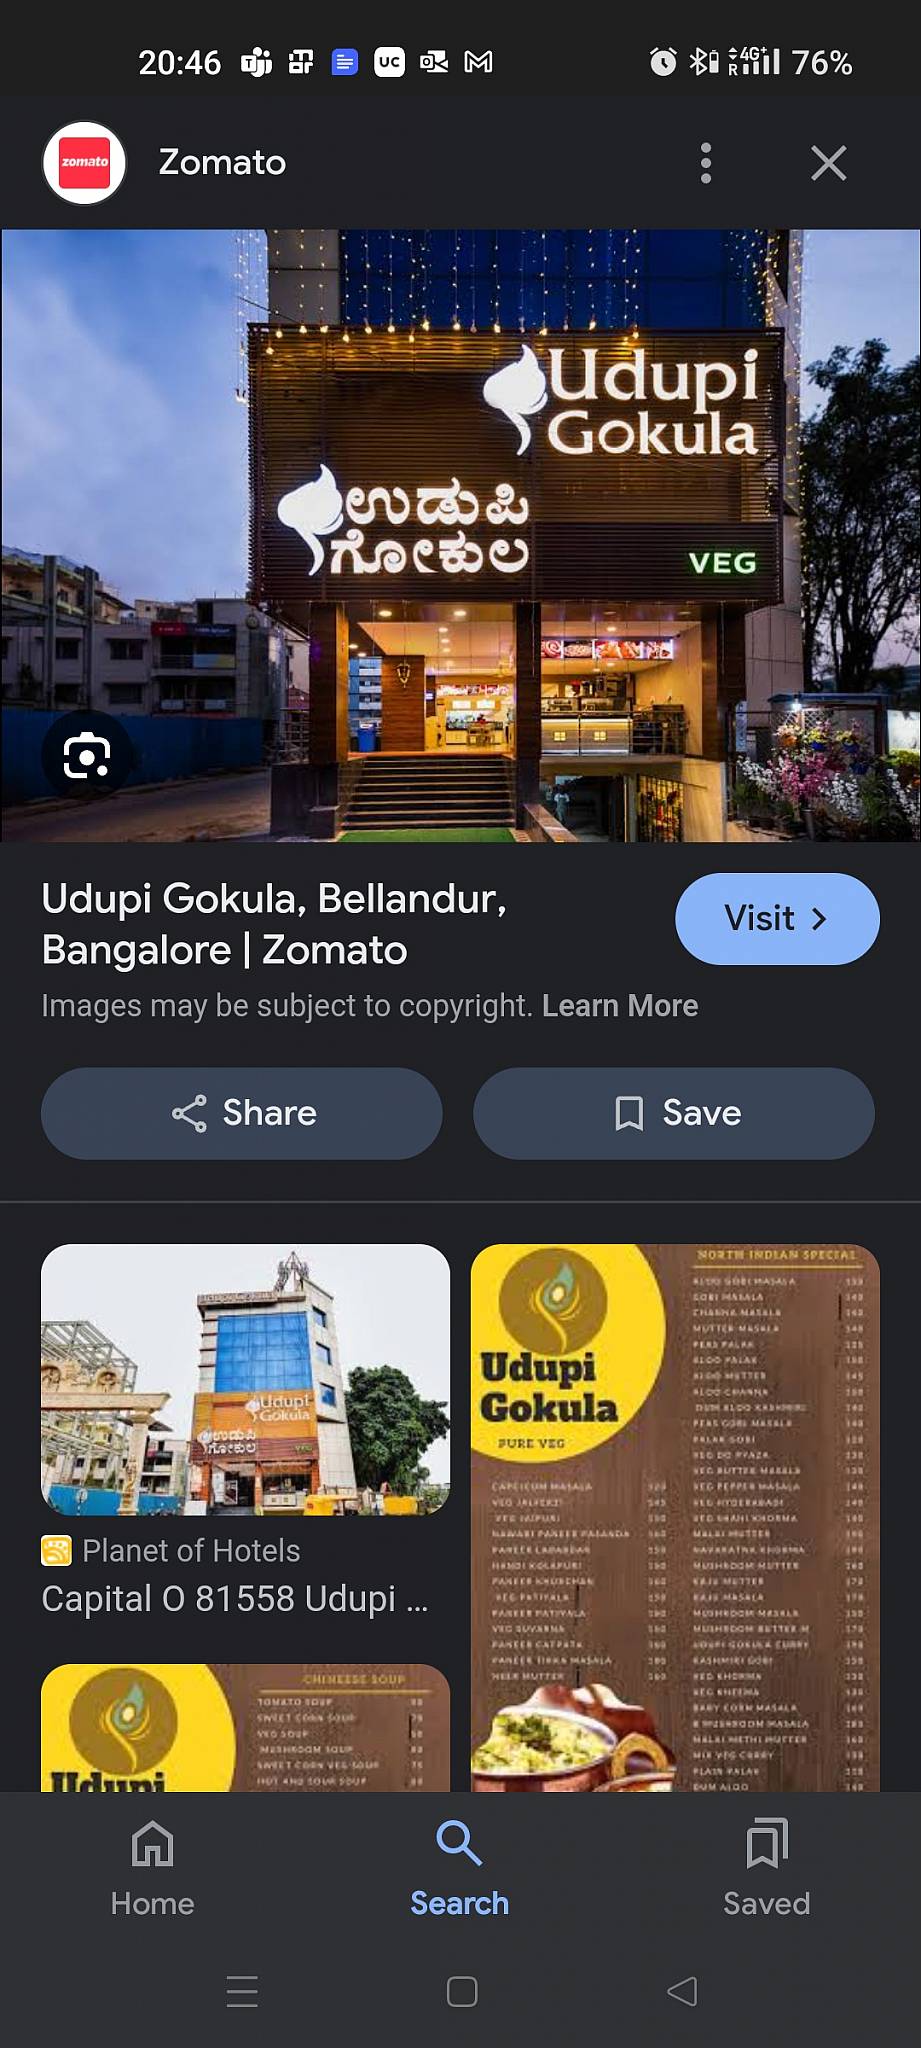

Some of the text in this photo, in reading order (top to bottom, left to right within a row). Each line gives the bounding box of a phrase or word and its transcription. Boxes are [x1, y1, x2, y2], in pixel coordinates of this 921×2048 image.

[139, 50, 221, 75] 20:46
[380, 57, 399, 67] UC
[792, 50, 852, 75] 76%
[61, 154, 110, 169] zomato
[160, 148, 286, 175] Zomato
[548, 348, 760, 414] Udupi
[547, 411, 760, 456] Gokula
[345, 477, 530, 526] ಉಡುಪಿ
[330, 529, 530, 575] ಗೋಕುಲ
[688, 551, 757, 575] VEG
[43, 882, 505, 921] Udupi Gokula, Bellandur,
[725, 904, 794, 930] Visit
[44, 934, 231, 972] Bangalore
[263, 934, 407, 964] Zomato
[44, 992, 698, 1023] Images may be subject to copyright. Learn More
[224, 1098, 316, 1125] Share
[664, 1098, 741, 1125] Save
[698, 1250, 857, 1260] NORTH INDIAN SPECIAL
[480, 1352, 596, 1389] Udupi
[259, 1409, 311, 1422] Gokula
[480, 1392, 619, 1423] Gokula
[498, 1439, 565, 1449] PURE VEG
[84, 1538, 300, 1562] Planet of Hotels
[43, 1584, 150, 1619] Capital
[197, 1585, 294, 1611] 81558
[307, 1584, 394, 1619] Udupi
[371, 1674, 406, 1685] SOUP
[257, 1697, 303, 1707] TOMATO
[51, 1772, 165, 1792] Udupi
[112, 1892, 194, 1915] Home
[411, 1891, 508, 1915] Search
[724, 1892, 809, 1915] Saved
